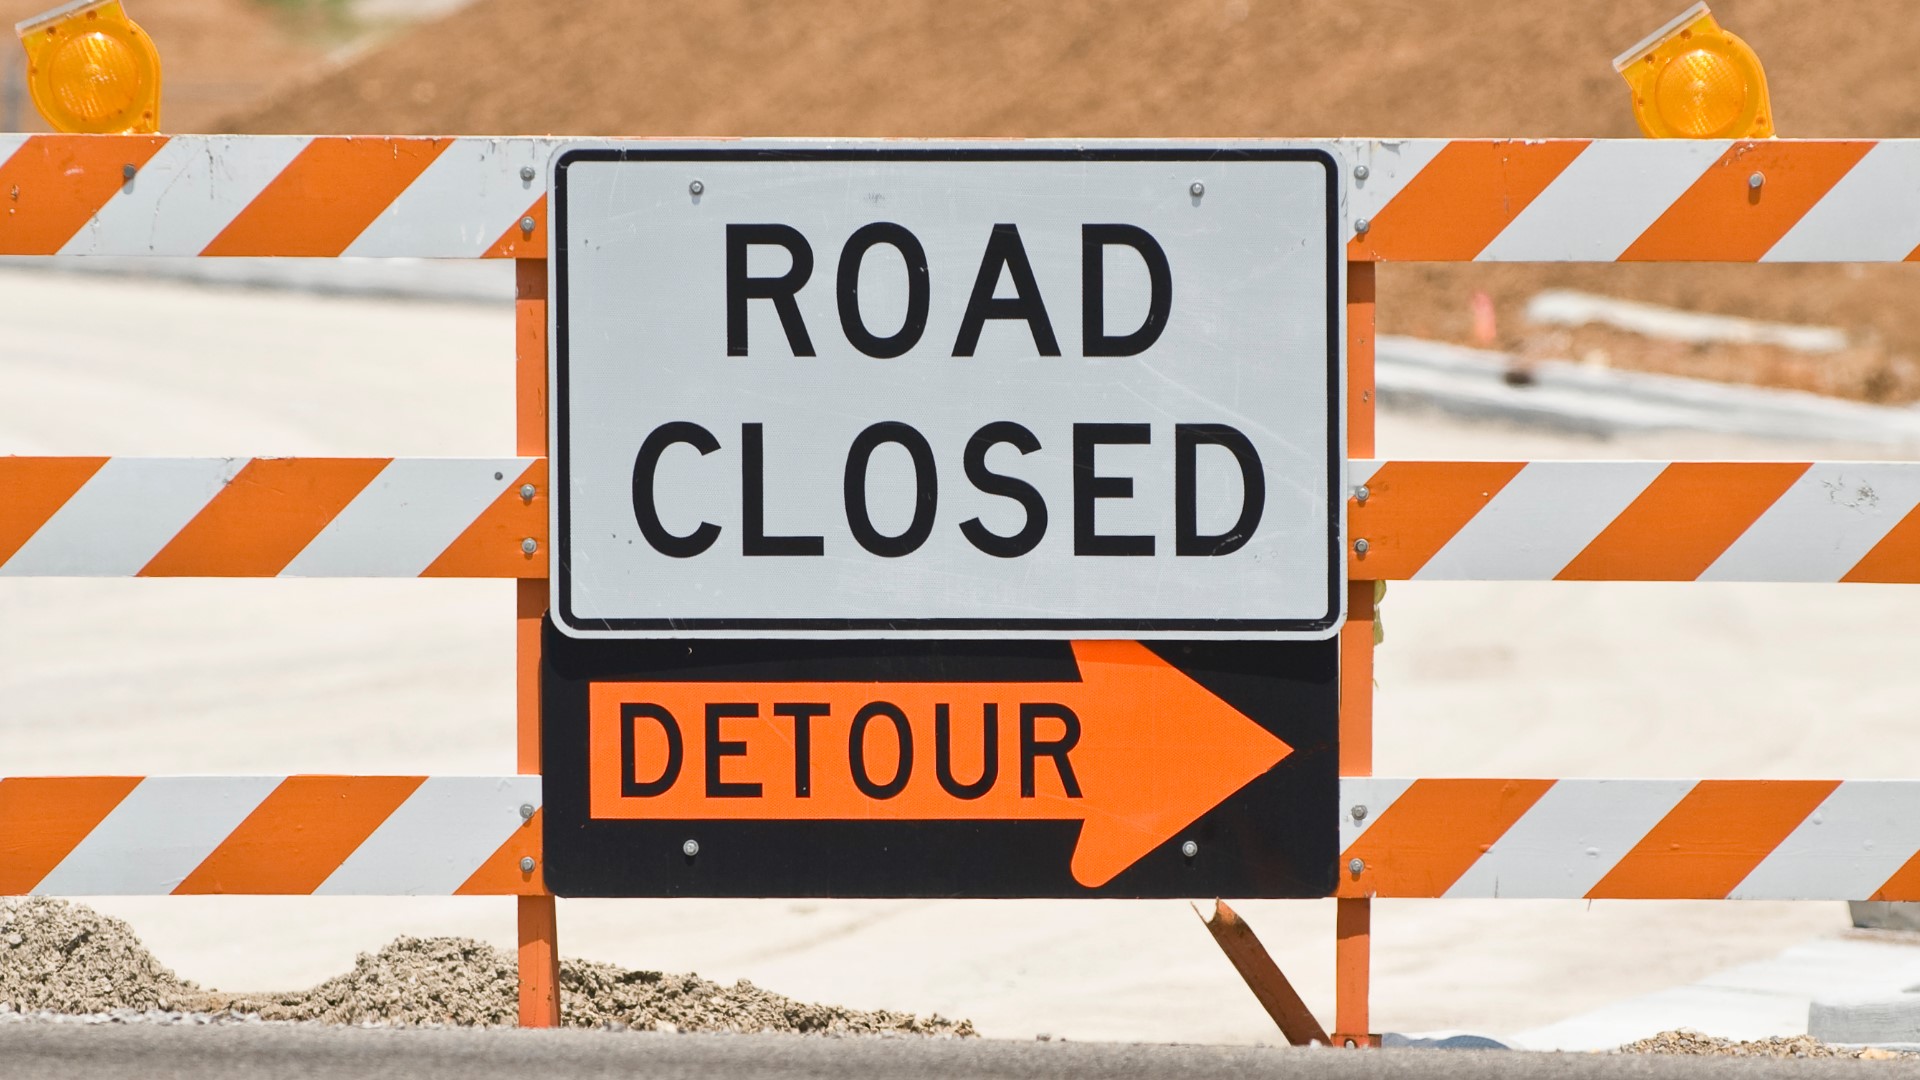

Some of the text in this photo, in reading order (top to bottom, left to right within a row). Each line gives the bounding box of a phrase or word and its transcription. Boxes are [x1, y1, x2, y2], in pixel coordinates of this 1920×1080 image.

[726, 222, 1172, 358] ROAD
[632, 421, 1265, 558] CLOSED
[620, 701, 1083, 799] DETOUR
